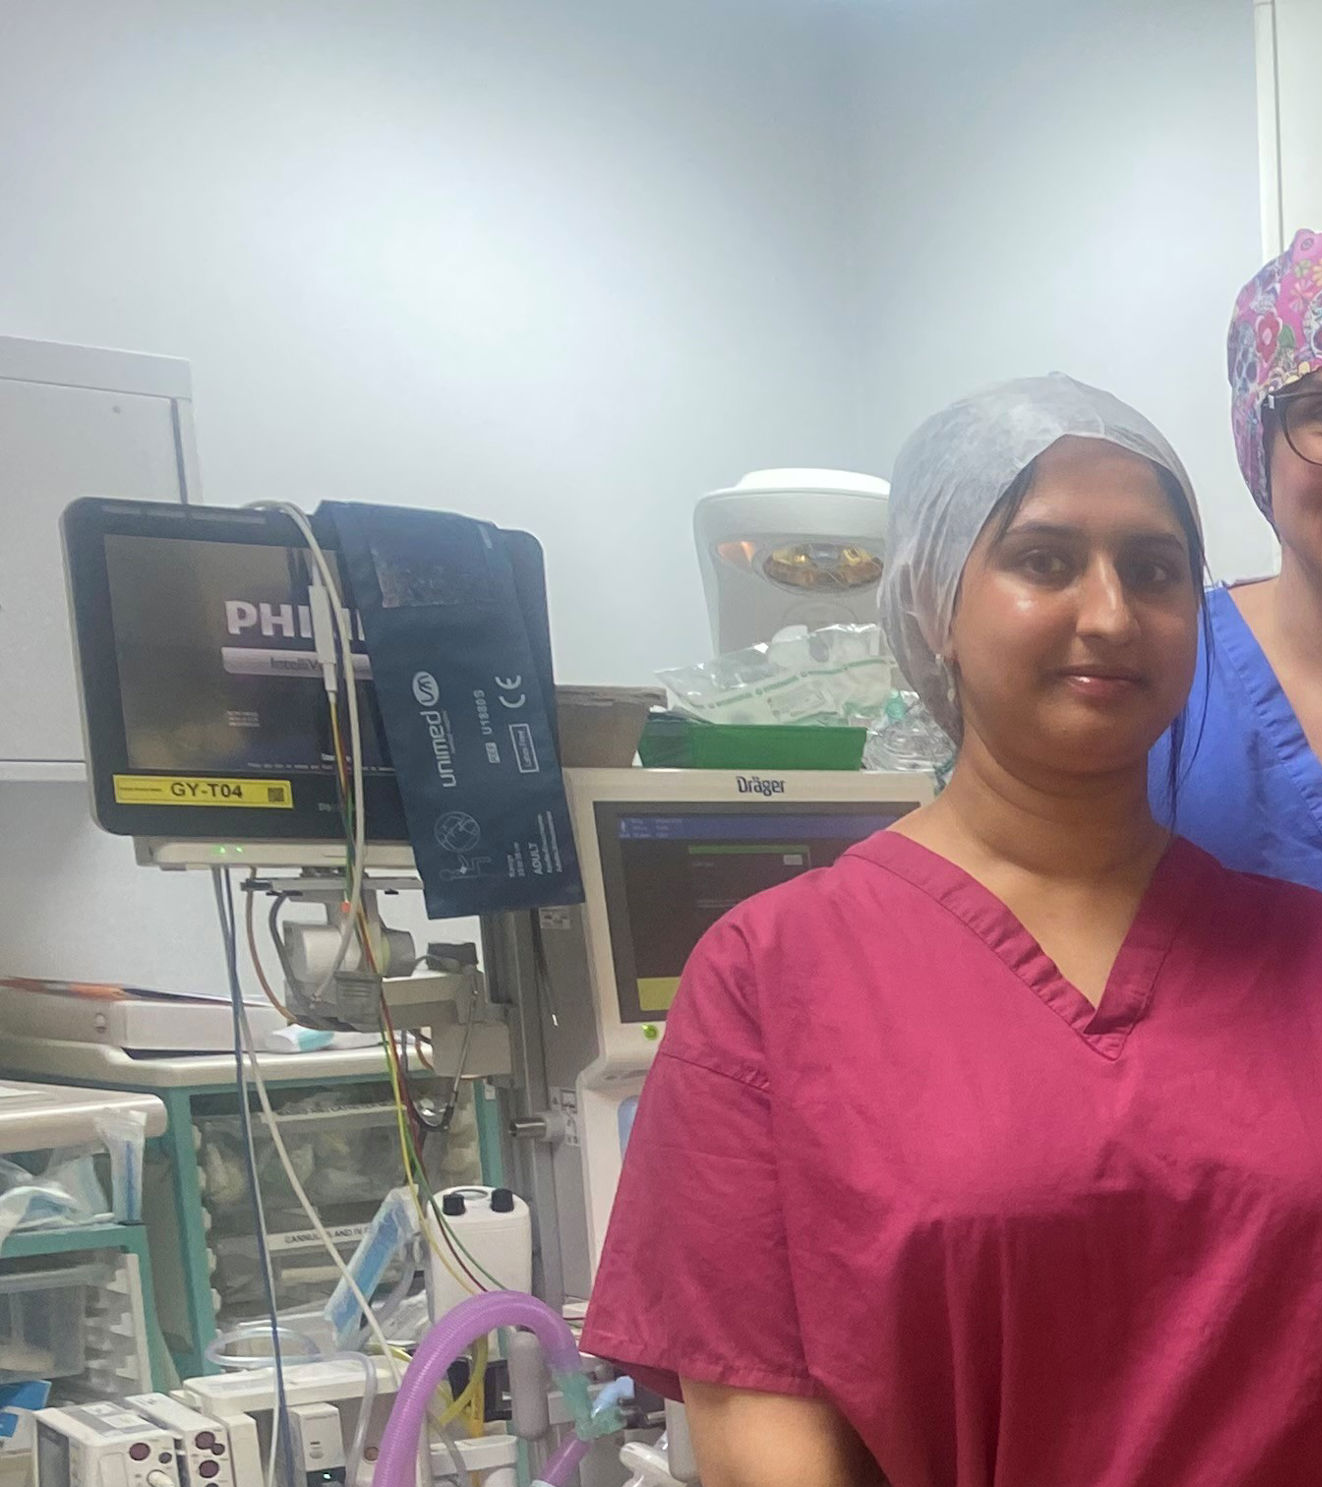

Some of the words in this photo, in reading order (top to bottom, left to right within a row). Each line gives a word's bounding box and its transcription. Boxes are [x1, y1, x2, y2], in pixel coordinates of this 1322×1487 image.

[225, 600, 365, 642] PHII
[420, 710, 456, 787] unimed
[171, 782, 242, 798] GY-T04
[736, 776, 785, 796] Dräger
[528, 843, 543, 875] ADULT
